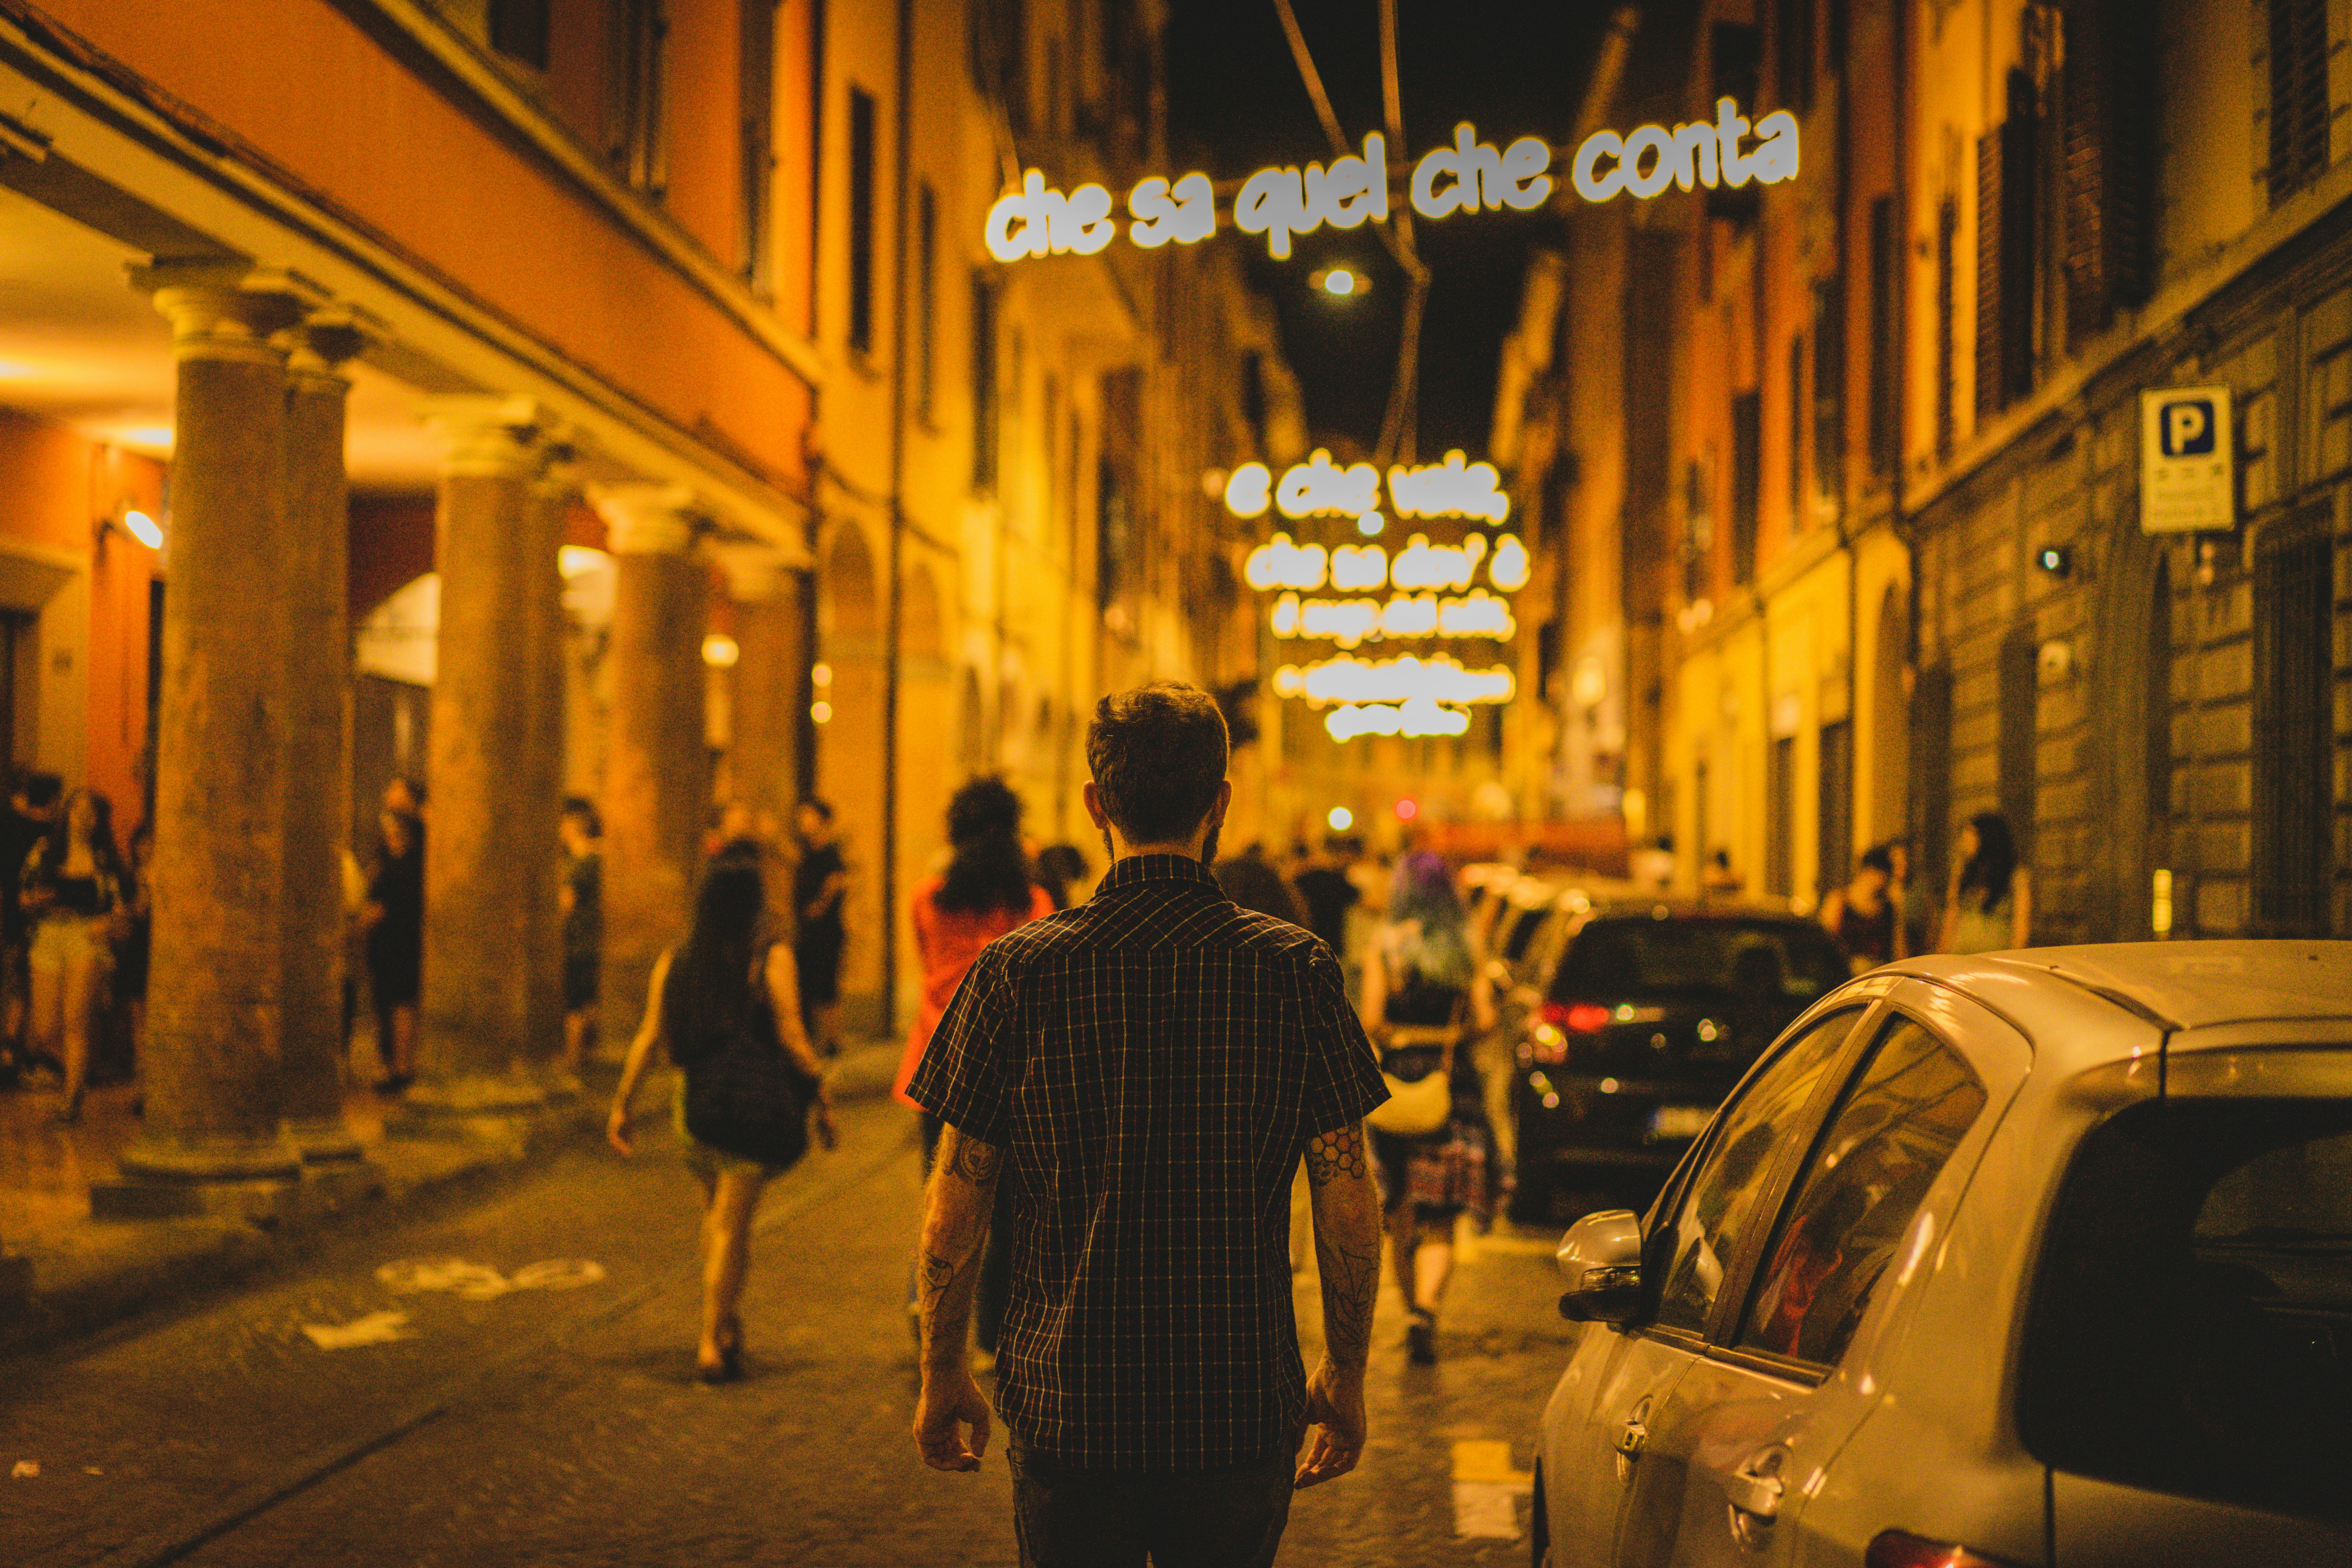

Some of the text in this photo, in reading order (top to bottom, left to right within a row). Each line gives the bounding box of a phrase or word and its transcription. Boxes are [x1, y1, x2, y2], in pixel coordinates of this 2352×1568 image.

[985, 98, 1799, 262] che sa quel che conta
[2169, 404, 2205, 453] P
